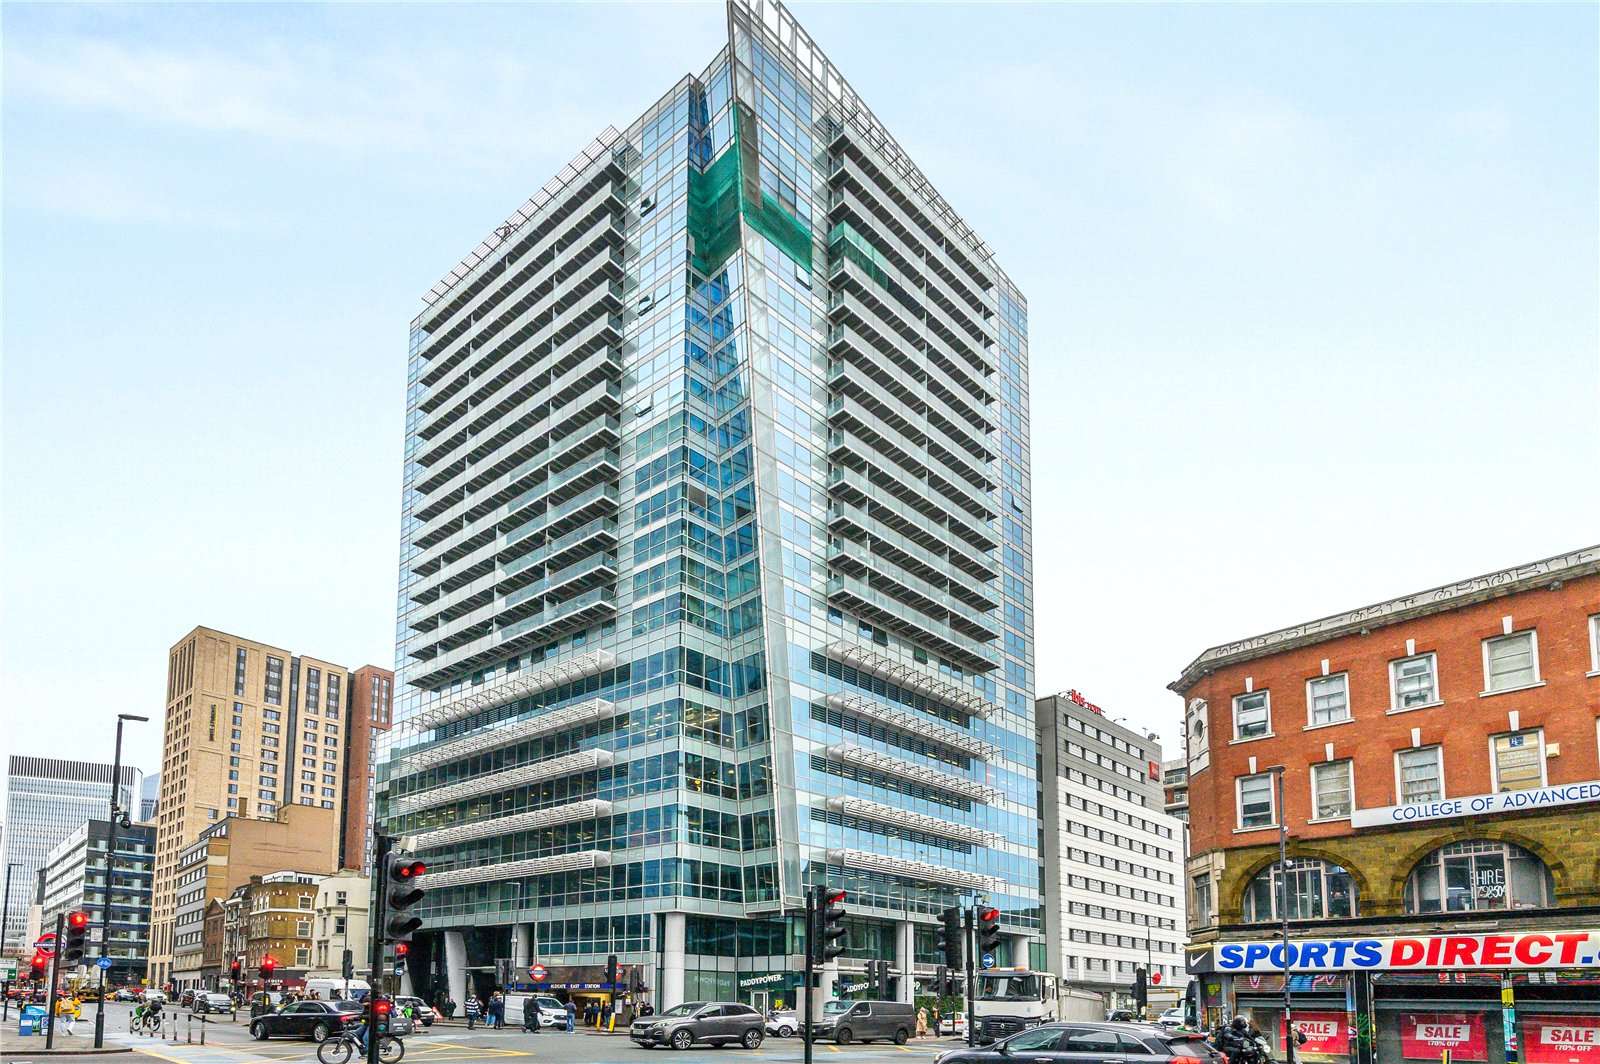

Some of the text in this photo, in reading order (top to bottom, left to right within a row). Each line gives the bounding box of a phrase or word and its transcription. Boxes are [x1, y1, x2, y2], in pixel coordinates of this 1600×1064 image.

[1392, 784, 1600, 821] COLLEGE OF ADVANCED
[1475, 868, 1505, 885] HIRE
[1218, 940, 1383, 969] SPORTS
[1300, 1023, 1330, 1034] SALE
[1424, 1026, 1462, 1038] SALE
[1550, 1030, 1594, 1042] SALE
